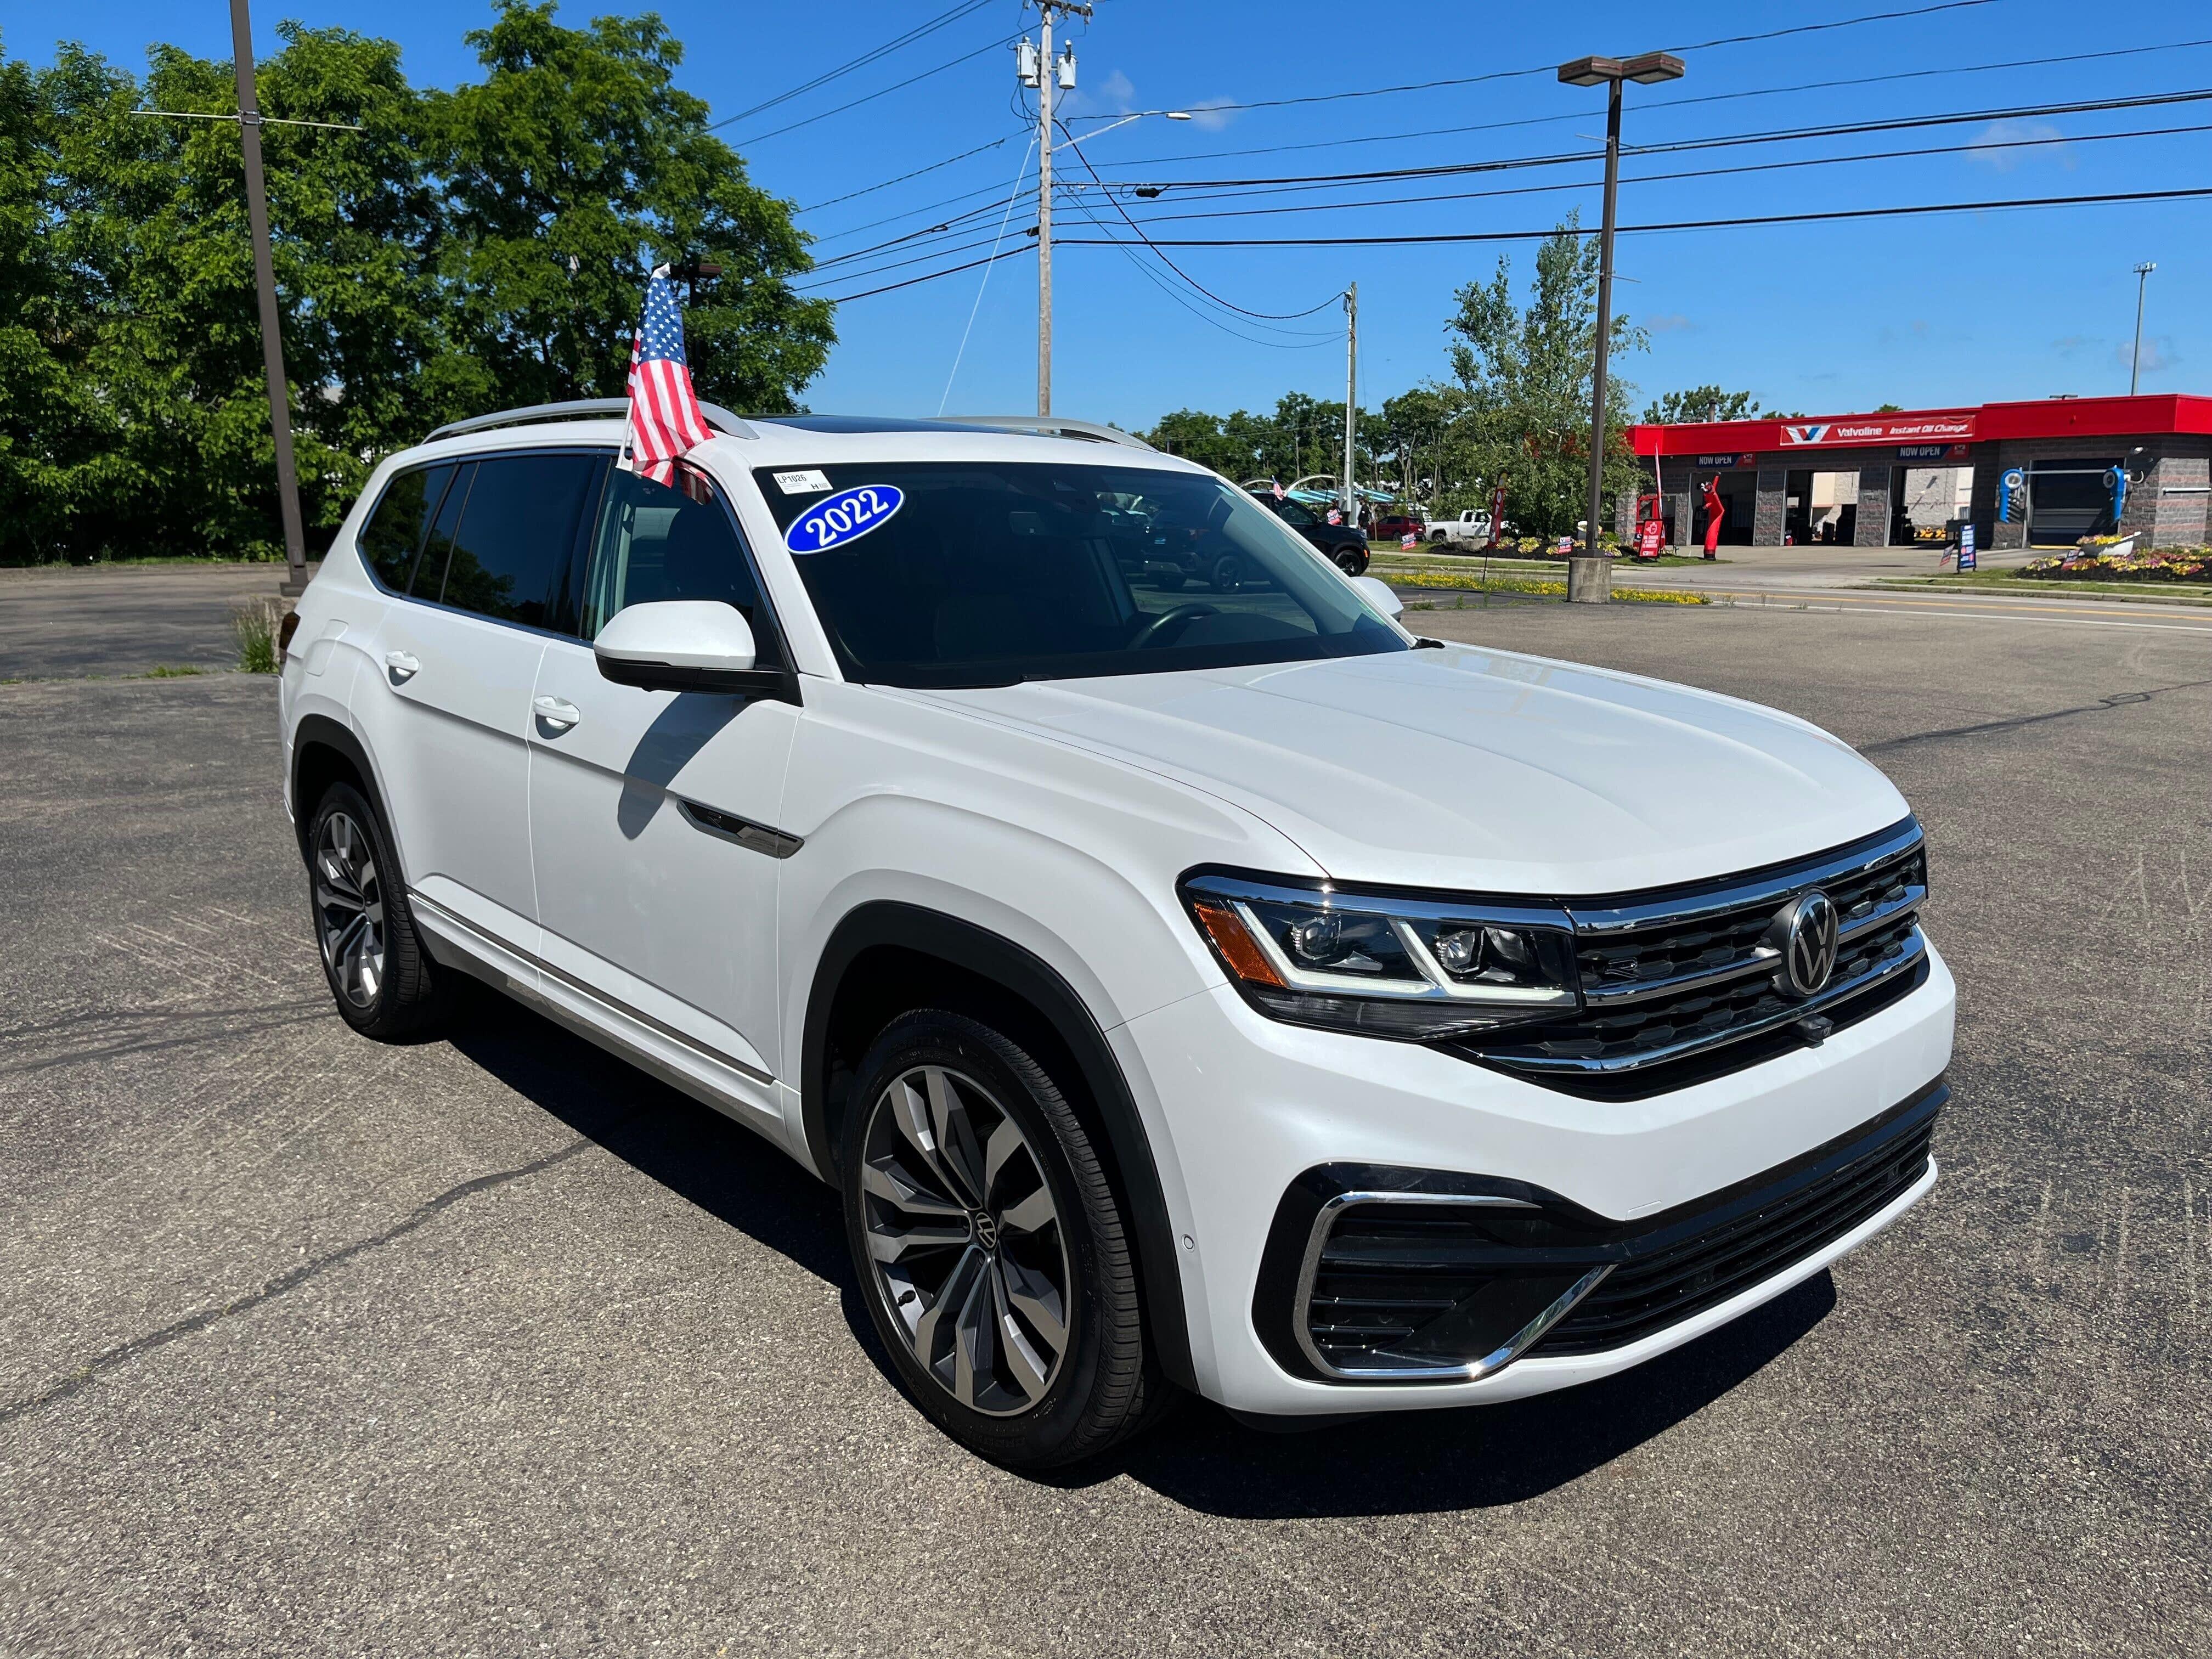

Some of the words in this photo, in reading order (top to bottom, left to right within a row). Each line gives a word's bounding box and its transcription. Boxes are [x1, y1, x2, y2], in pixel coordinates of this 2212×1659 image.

[1837, 427, 1882, 437] Valvoline
[1889, 426, 1921, 435] Instant
[1921, 425, 1935, 433] Oil
[1934, 424, 1968, 433] Change
[1900, 447, 1918, 456] NOW
[1920, 446, 1940, 455] OPEN
[1699, 456, 1713, 465] NOW
[1714, 455, 1731, 464] OPEN
[777, 475, 807, 483] LP1026
[805, 489, 889, 546] 2022
